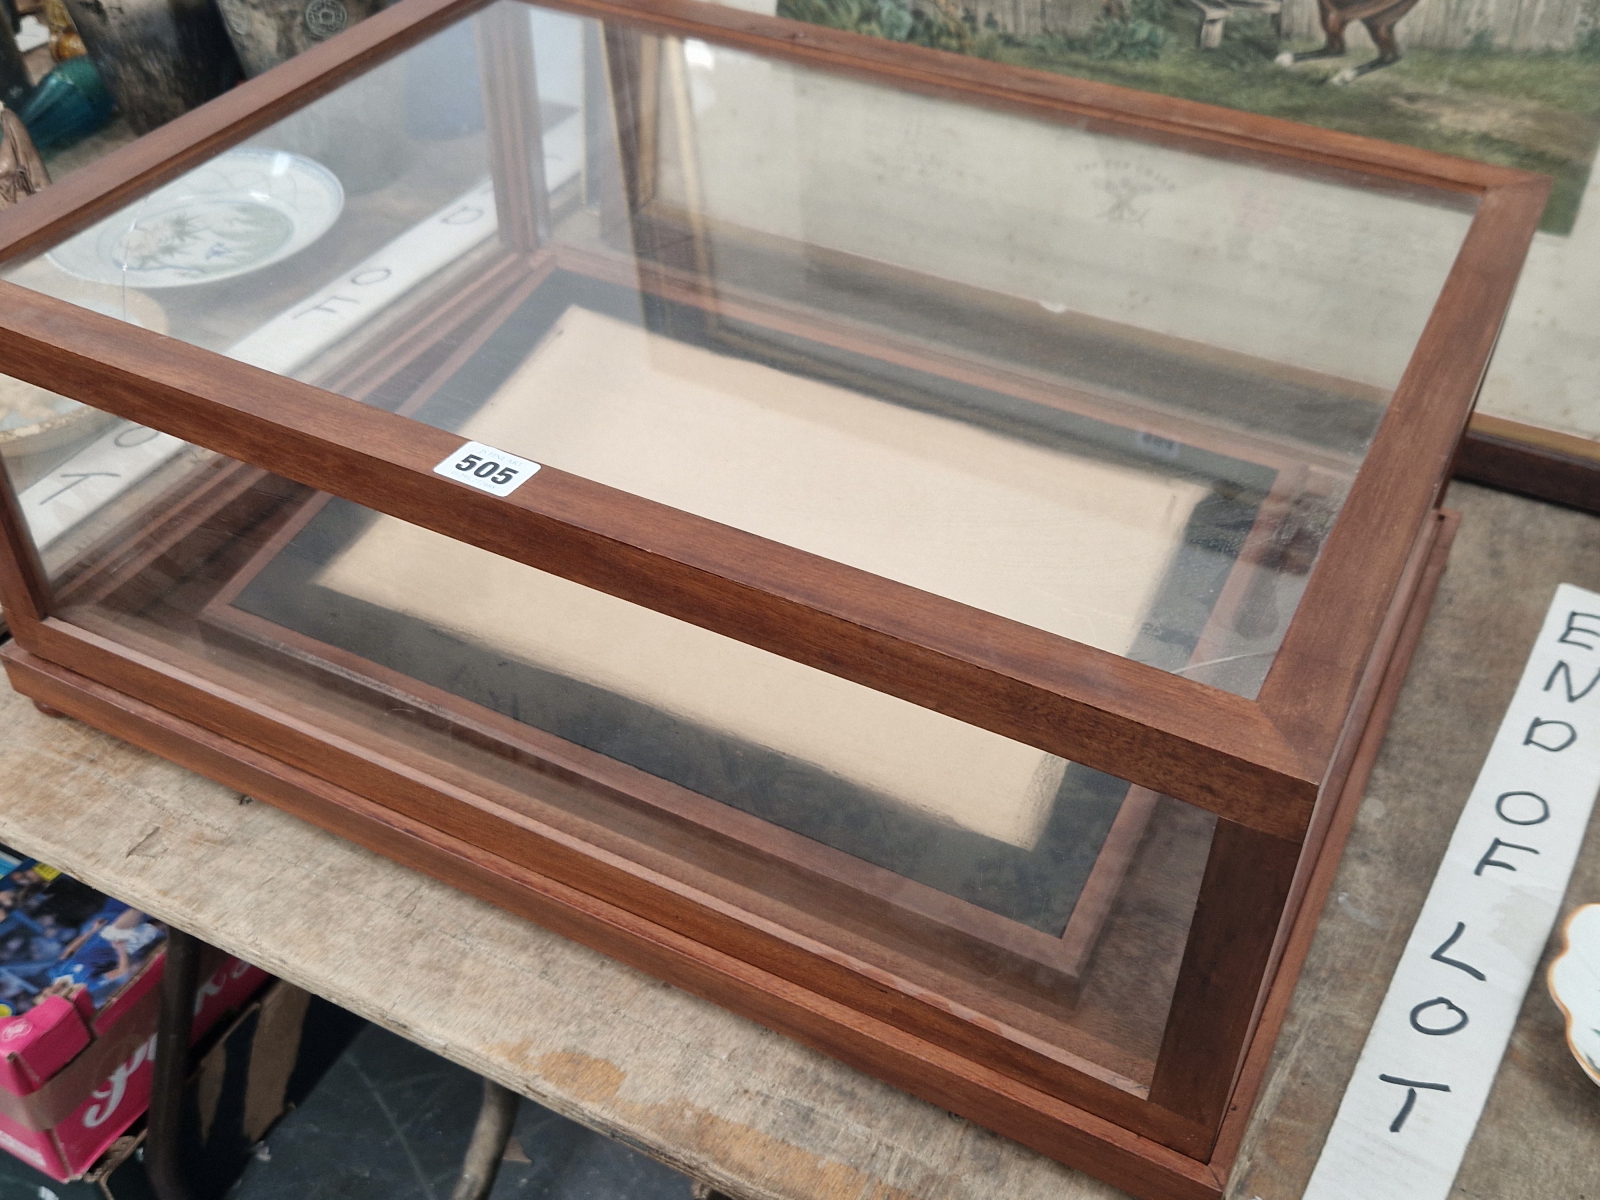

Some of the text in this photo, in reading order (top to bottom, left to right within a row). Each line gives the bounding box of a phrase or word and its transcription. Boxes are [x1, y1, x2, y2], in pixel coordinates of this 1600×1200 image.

[455, 453, 519, 485] 505
[1379, 611, 1600, 1132] END OF LOT
